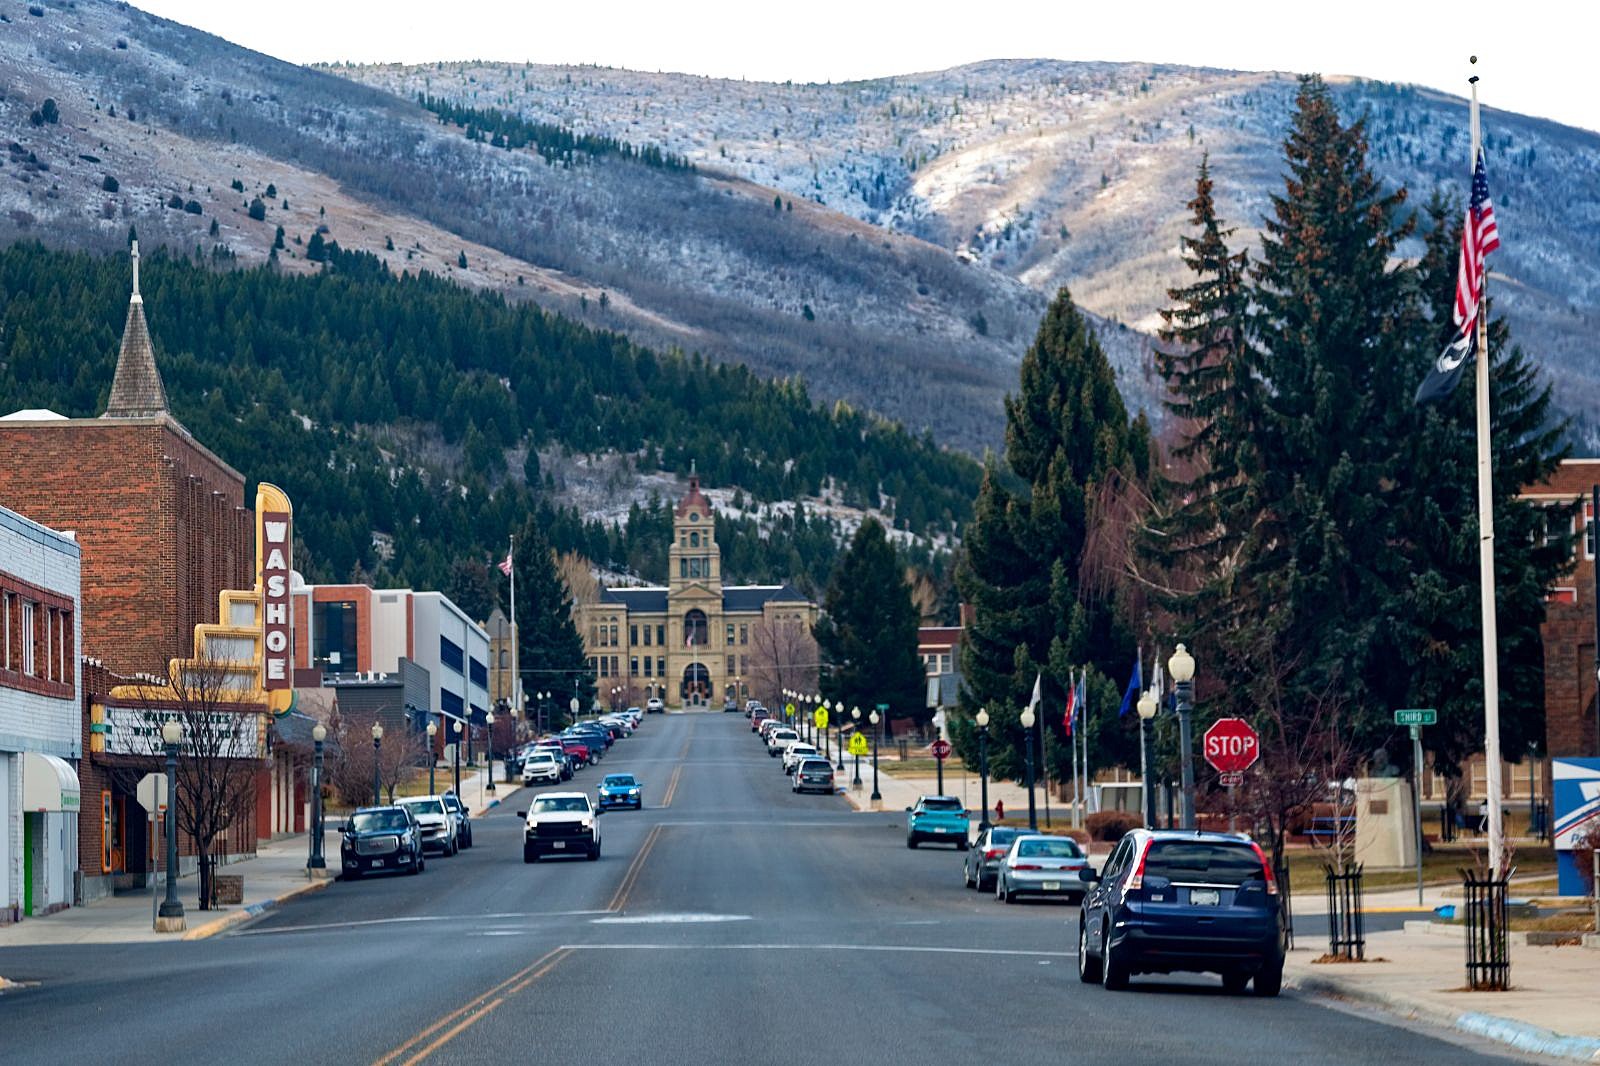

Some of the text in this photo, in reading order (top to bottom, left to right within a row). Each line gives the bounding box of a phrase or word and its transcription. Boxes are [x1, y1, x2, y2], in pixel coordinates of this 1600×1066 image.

[264, 521, 287, 680] WASHOE
[933, 745, 951, 754] SOP
[1208, 736, 1255, 756] STOP
